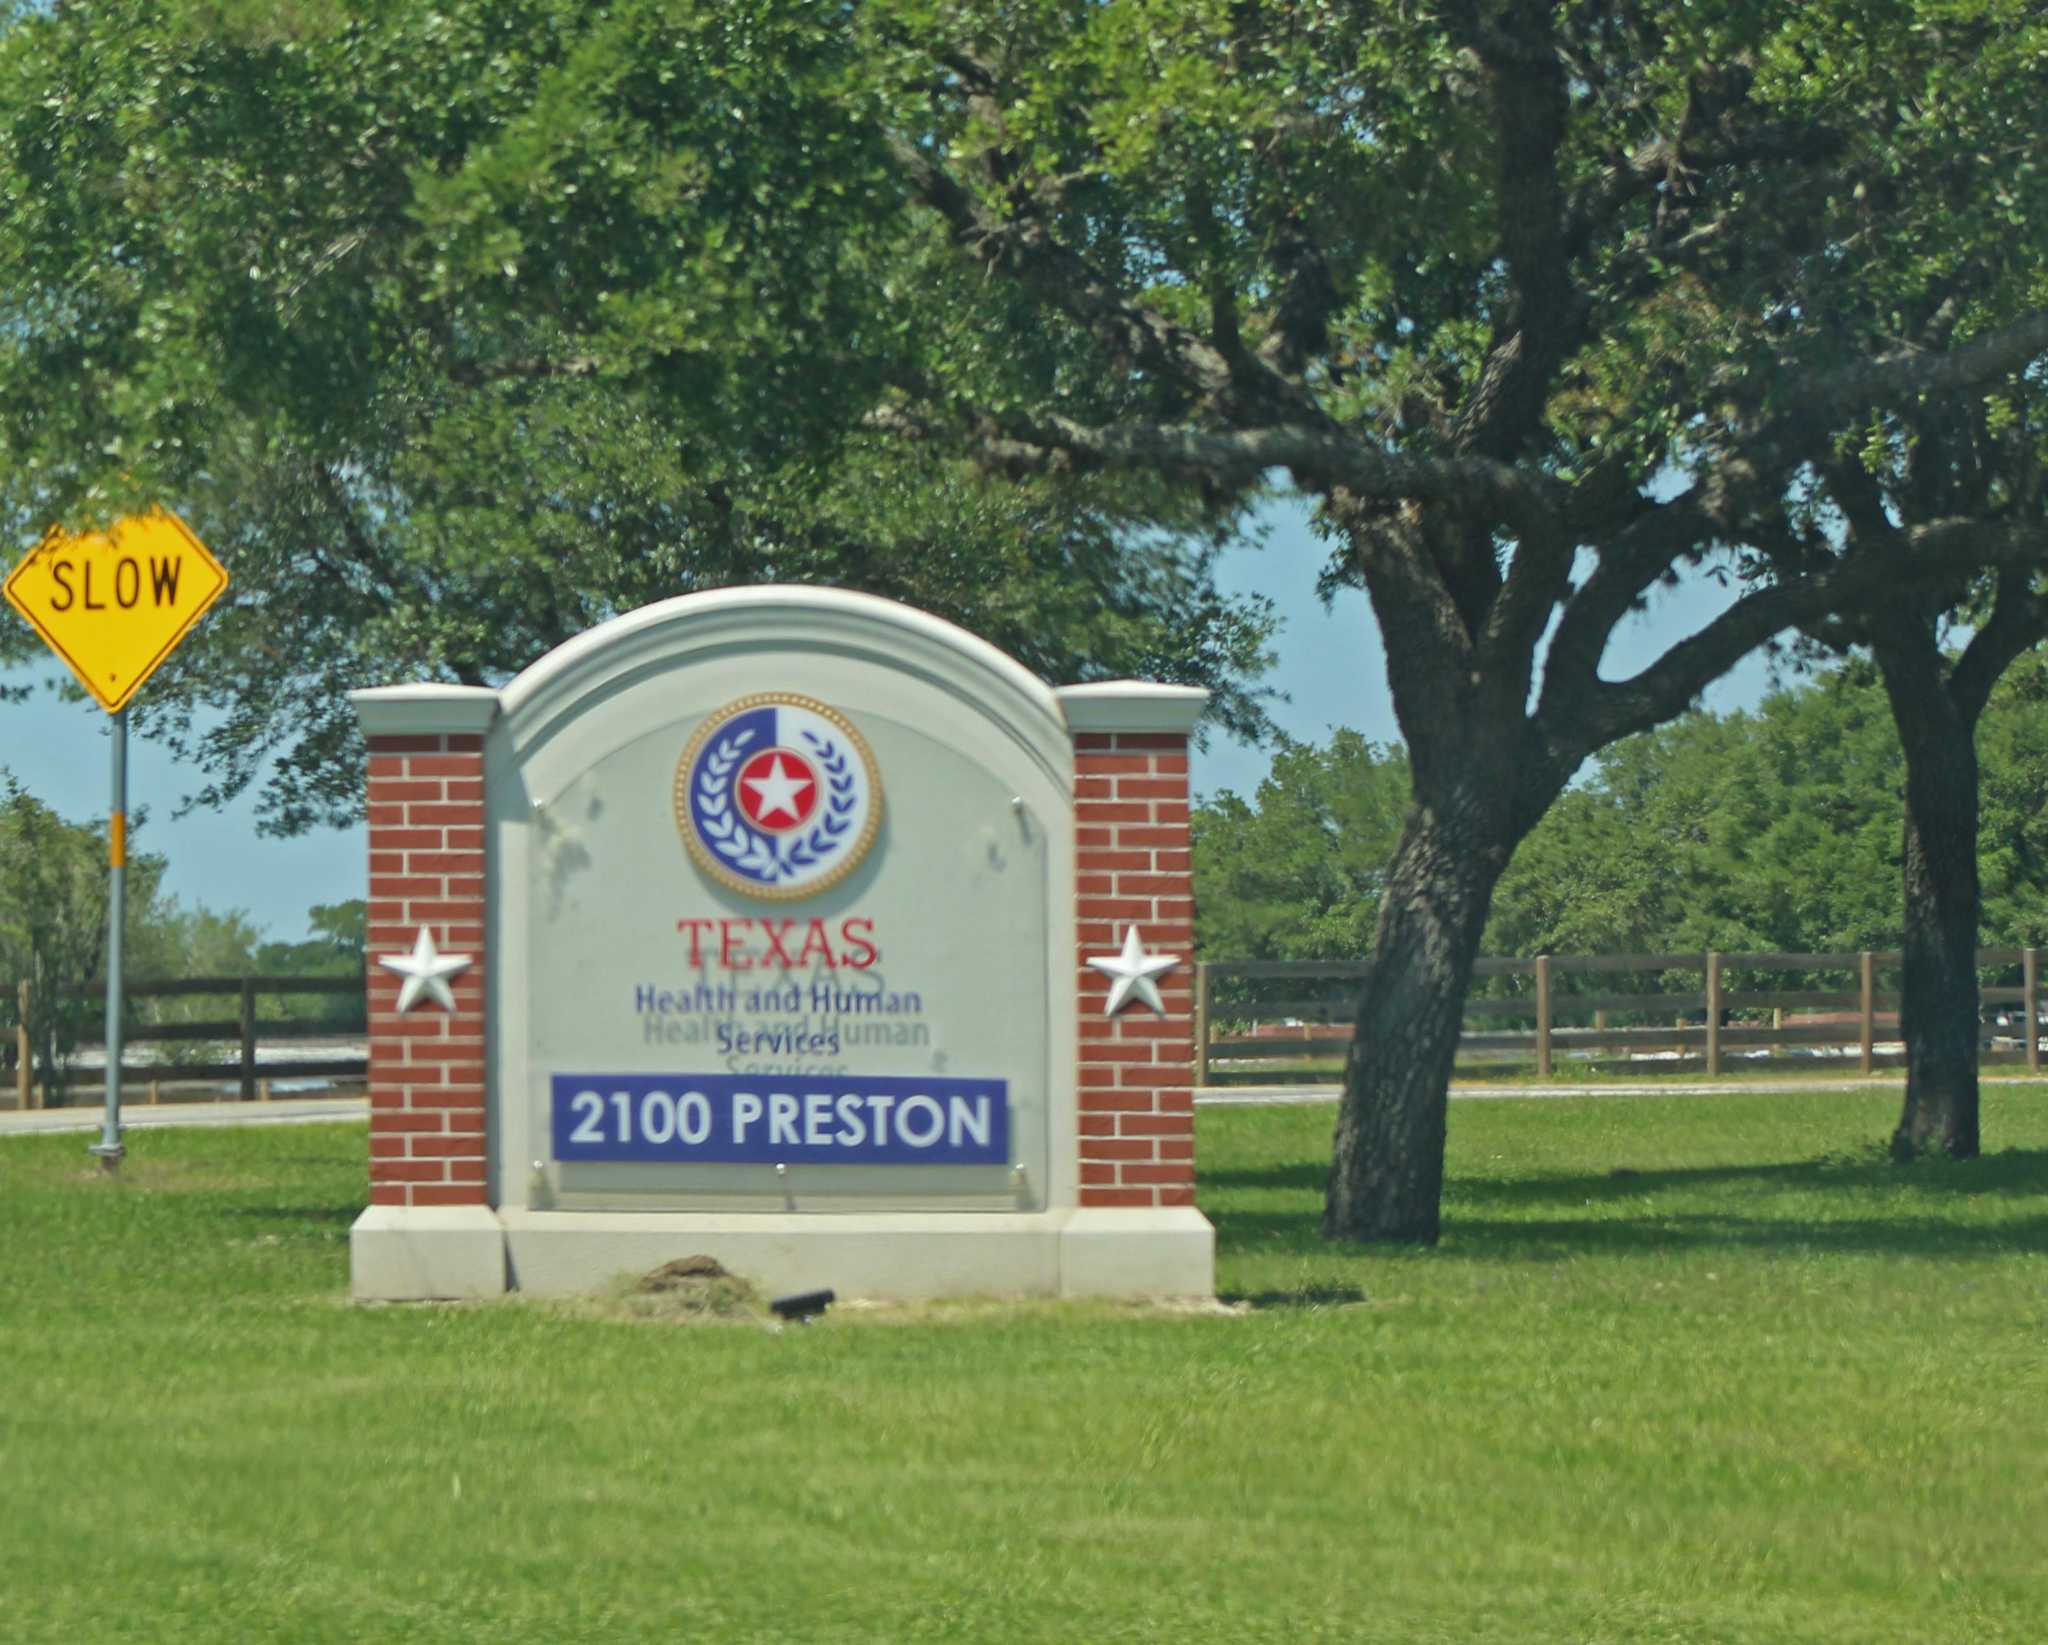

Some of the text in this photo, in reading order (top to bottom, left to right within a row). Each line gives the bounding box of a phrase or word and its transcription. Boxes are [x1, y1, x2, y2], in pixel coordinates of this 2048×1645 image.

[50, 556, 181, 612] SLOW
[677, 918, 879, 970] TEXAS
[635, 983, 922, 1014] Health and Human
[717, 1023, 840, 1056] Services
[569, 1091, 991, 1148] 2100 PRESTON
